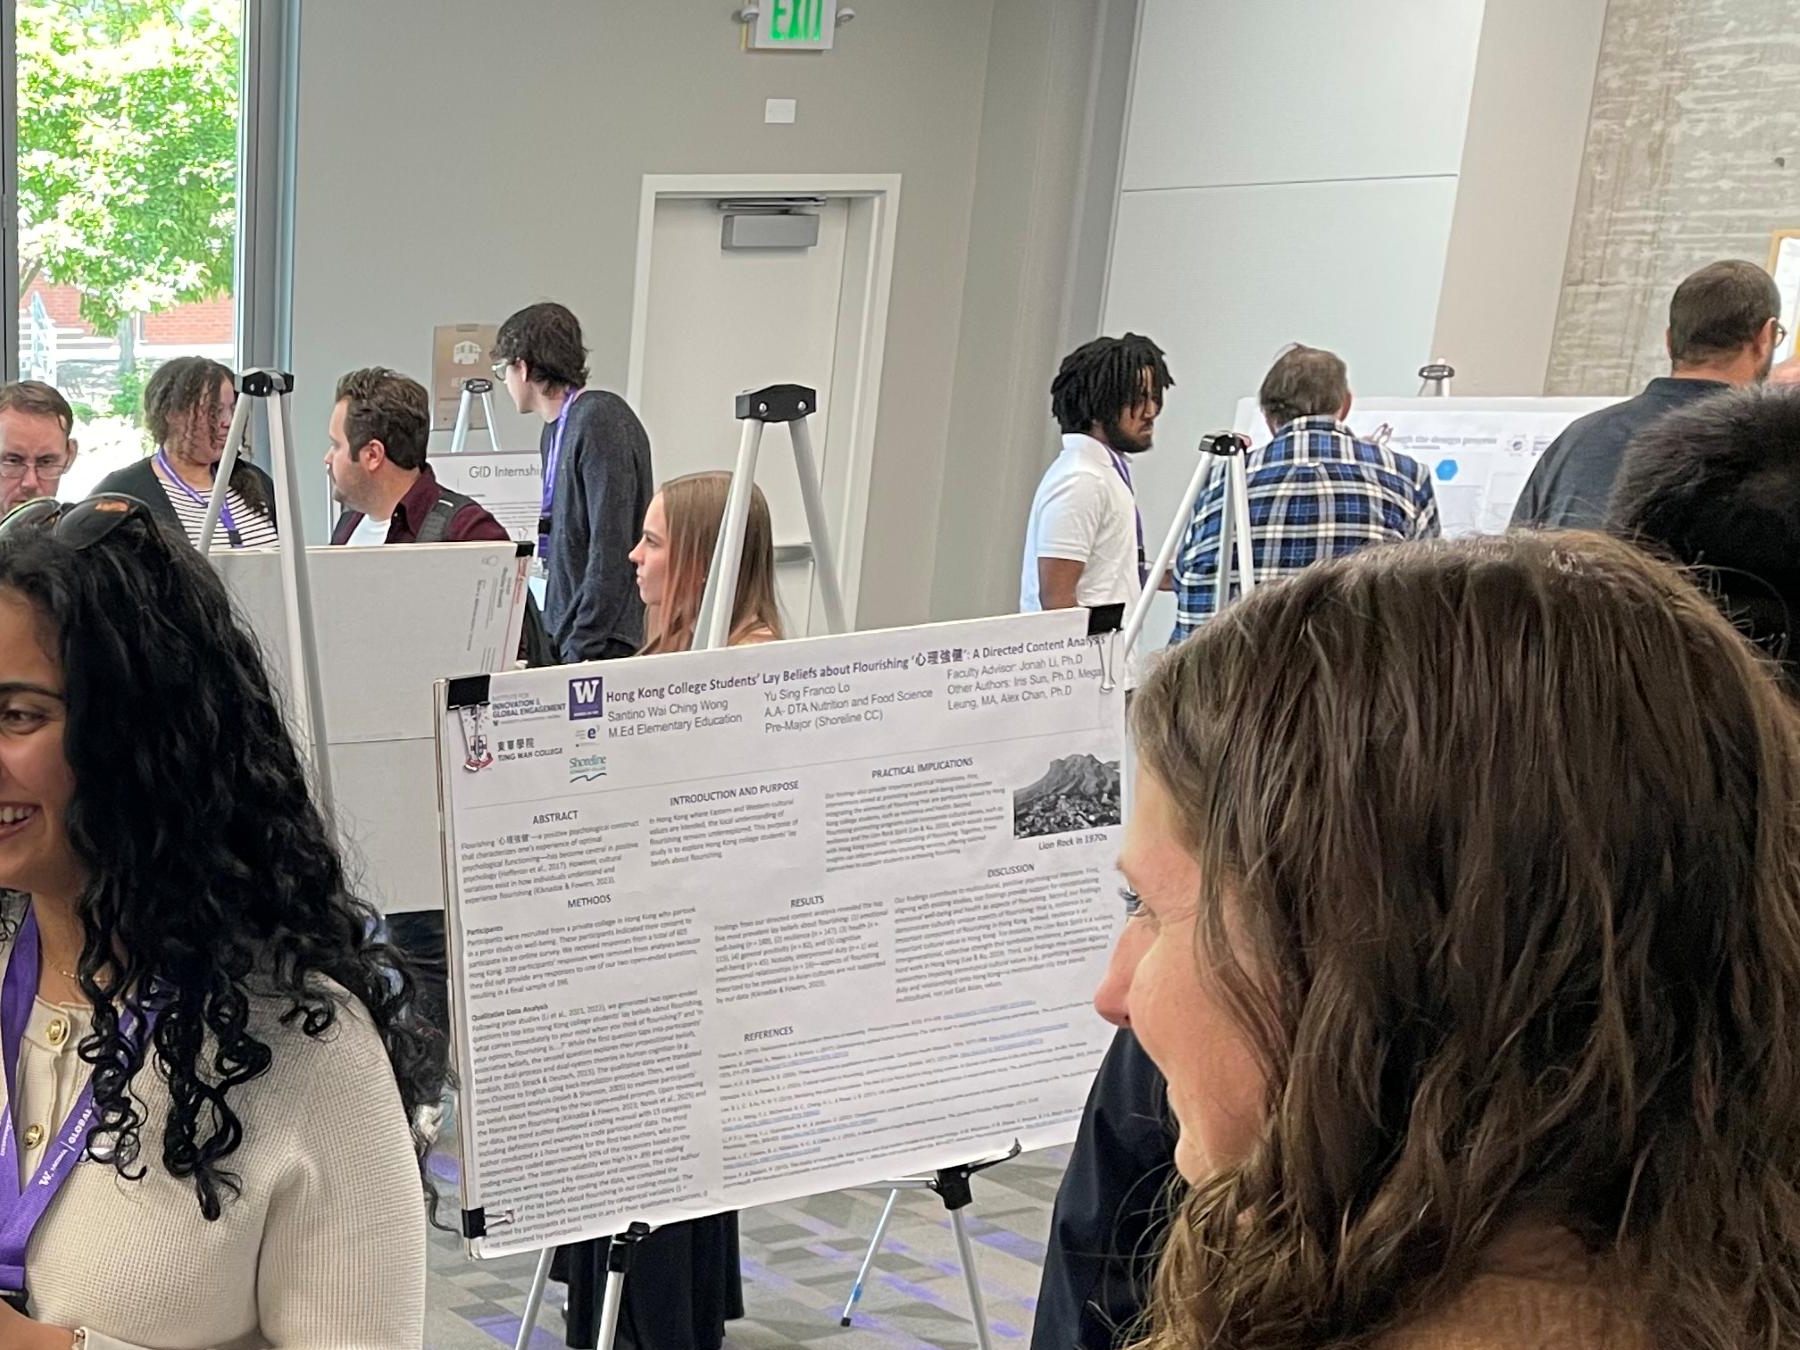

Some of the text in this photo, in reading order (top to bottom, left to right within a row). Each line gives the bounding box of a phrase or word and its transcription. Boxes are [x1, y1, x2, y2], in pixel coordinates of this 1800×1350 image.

[469, 465, 542, 478] GID Internshi
[607, 690, 634, 704] Hong
[640, 686, 664, 700] Kong
[668, 680, 707, 696] College
[763, 672, 779, 686] Lay
[784, 668, 817, 681] Beliefs
[820, 664, 849, 677] about
[853, 657, 908, 674] Flourishing
[973, 649, 979, 659] A
[983, 644, 1023, 657] Directed
[1026, 640, 1064, 652] Content
[947, 667, 978, 681] Faculty
[1020, 659, 1046, 670] Jonah
[1062, 654, 1082, 665] Ph.D
[572, 680, 599, 705] W
[764, 682, 849, 702] Yu Sing Franco Lo
[947, 683, 972, 695] Other
[1031, 674, 1048, 685] Sun,
[788, 703, 808, 714] DTA
[810, 699, 849, 711] Nutrition
[851, 697, 868, 706] and
[872, 693, 894, 704] Food
[897, 688, 932, 701] Science
[948, 698, 978, 712] Leung,
[1001, 693, 1019, 703] Alex
[1051, 686, 1071, 697] Ph.D
[493, 708, 519, 718] GLOBAL
[520, 703, 566, 715] ENGAGEMENT
[608, 708, 644, 722] Santino
[648, 706, 666, 717] Wai
[669, 703, 697, 716] Ching
[700, 699, 728, 712] Wong
[609, 713, 742, 738] M.Ed Elementary Education
[766, 709, 883, 734] Pre-Major (Shoreline CC)
[872, 758, 973, 779] PRACTICAL IMPLICATIONS
[670, 781, 799, 805] INTRODUCTION AND PURPOSE
[533, 811, 578, 824] ABSTRACT
[1038, 841, 1055, 851] Lion
[1057, 838, 1075, 849] Rock
[988, 863, 1034, 878] DISCUSSION
[568, 894, 611, 909] METHODS
[791, 895, 824, 909] RESULTS
[467, 925, 503, 936] Participants
[506, 1006, 521, 1016] Data
[523, 1002, 548, 1014] Analysis
[744, 1025, 793, 1042] REFERENCES
[68, 1109, 92, 1144] GLOBAL
[39, 1171, 51, 1185] W
